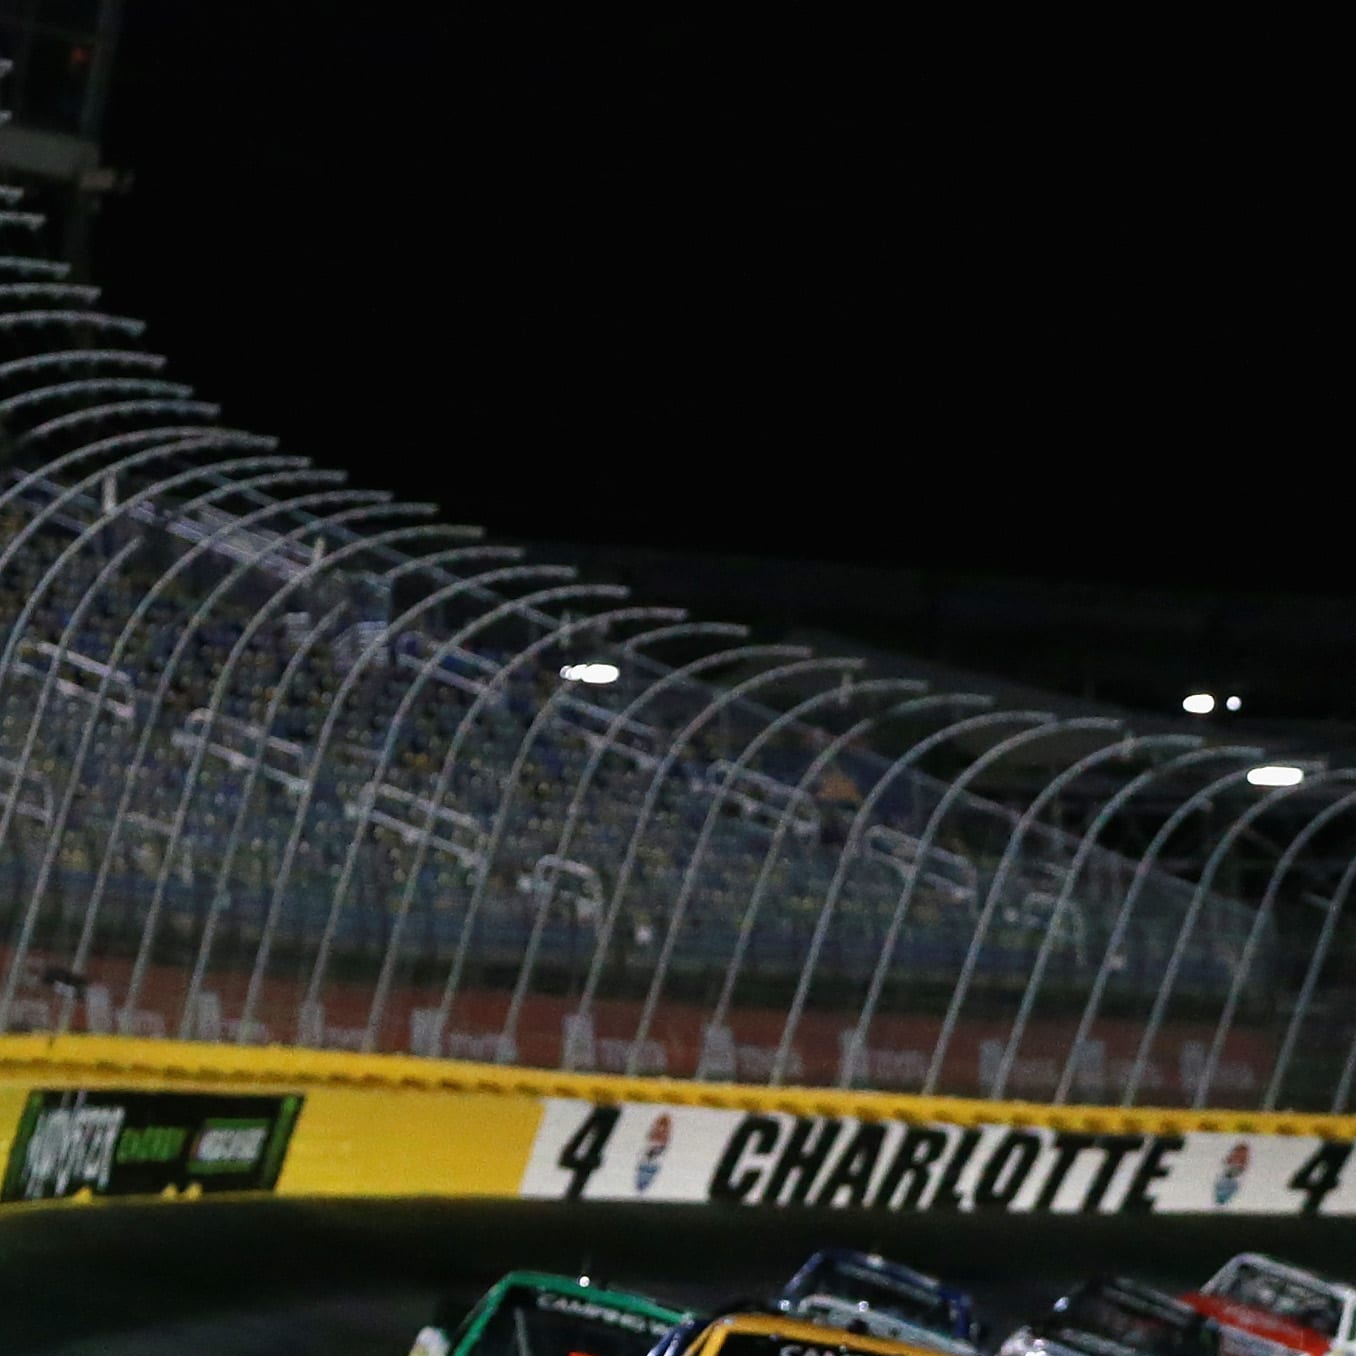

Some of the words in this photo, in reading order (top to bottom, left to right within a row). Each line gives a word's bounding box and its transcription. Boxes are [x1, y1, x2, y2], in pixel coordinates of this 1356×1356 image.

[558, 1104, 622, 1199] 4
[709, 1112, 1185, 1213] CHARLOTTE
[1288, 1137, 1353, 1214] 4
